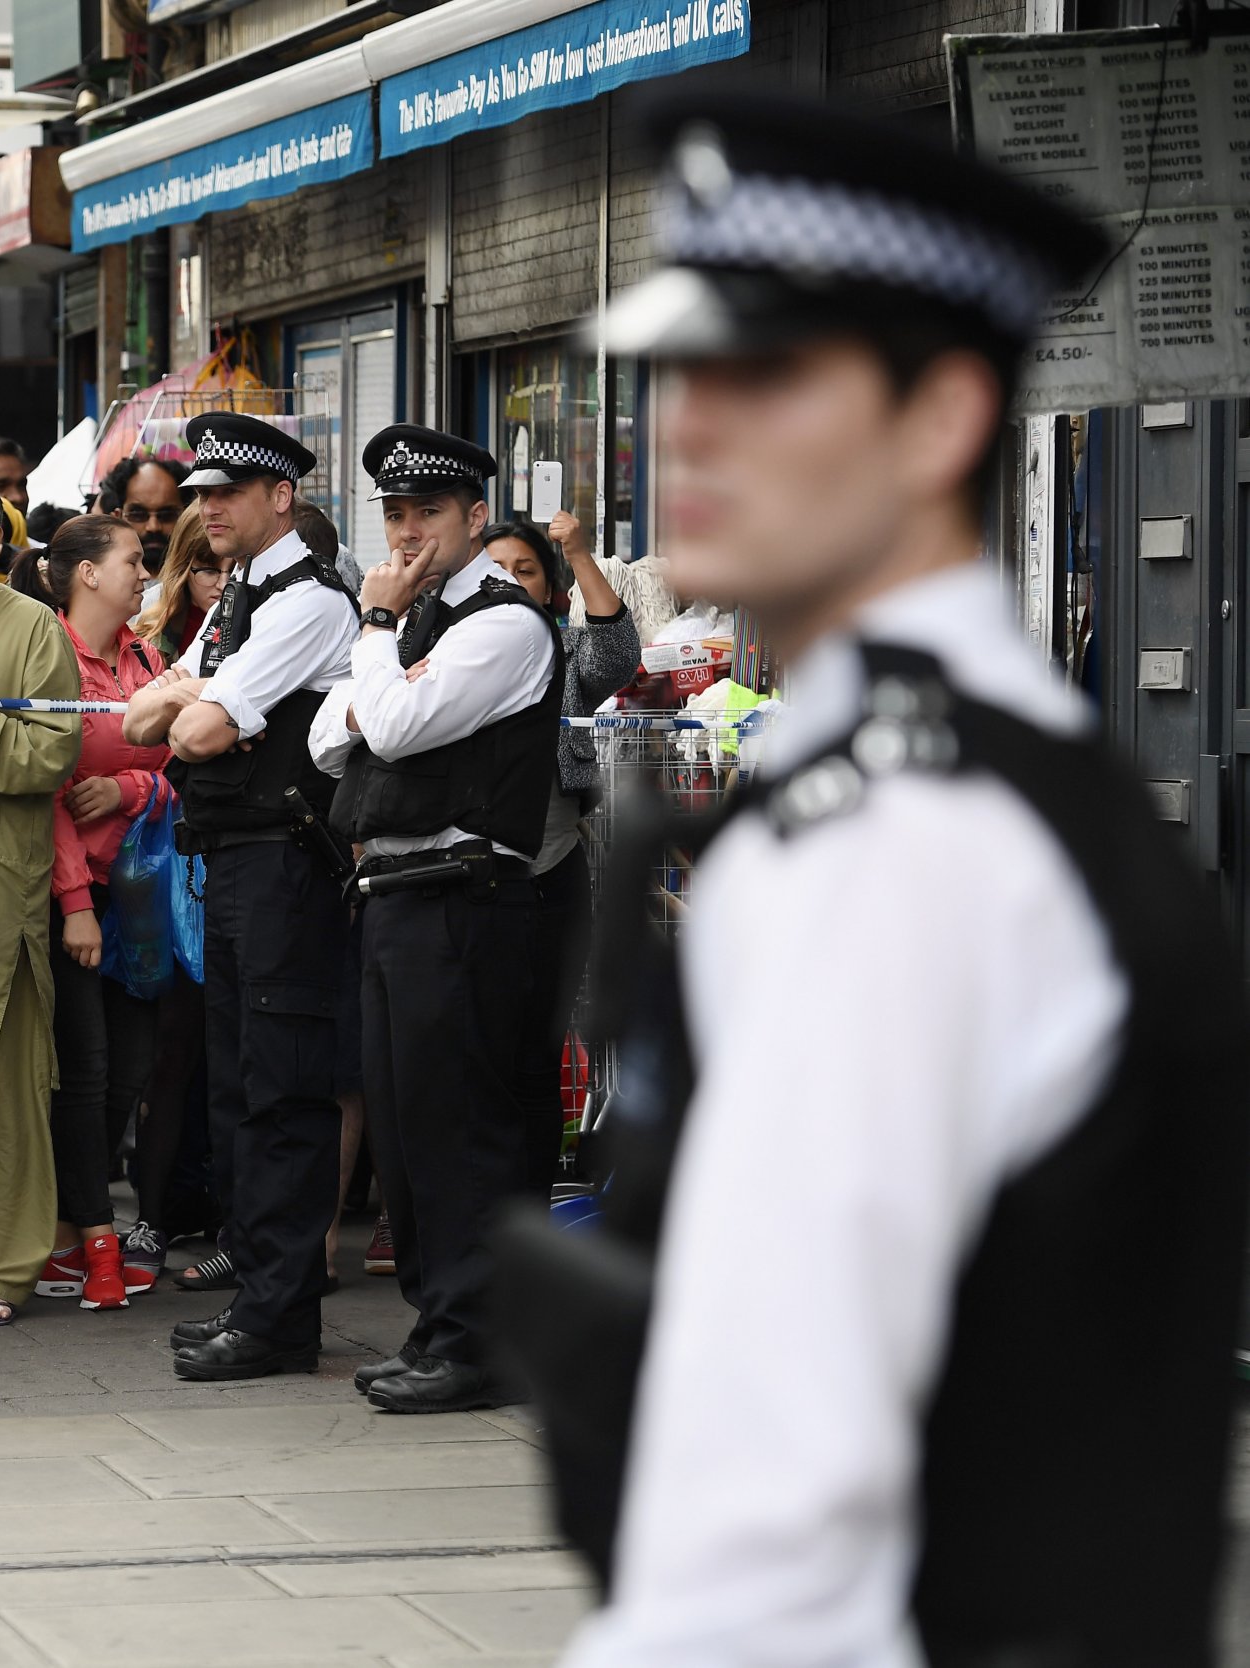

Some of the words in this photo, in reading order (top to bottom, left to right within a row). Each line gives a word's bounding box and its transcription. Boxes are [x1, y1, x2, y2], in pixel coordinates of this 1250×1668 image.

[1101, 51, 1150, 64] NIGERIA
[399, 99, 414, 134] The
[414, 92, 433, 129] UK's
[434, 80, 469, 124] favourite
[468, 74, 486, 115] Pay
[486, 68, 500, 105] As
[501, 64, 516, 100] You
[518, 58, 530, 95] Go
[529, 50, 548, 91] SIM
[547, 47, 564, 85] for
[565, 43, 584, 81] low
[586, 33, 605, 74] cost
[605, 10, 671, 67] International
[673, 3, 691, 48] and
[692, 0, 710, 41] UK
[982, 60, 1027, 71] MOBILE
[989, 90, 1036, 102] LEBARA
[1040, 86, 1086, 98] MOBILE
[1010, 103, 1066, 116] VECTONE
[1118, 99, 1138, 110] 100
[1143, 108, 1197, 122] MNUTES
[1014, 119, 1064, 131] DELIGHT
[1145, 124, 1199, 137] MNUTES
[1003, 137, 1031, 147] NOW
[1034, 133, 1080, 144] MOBILE
[998, 152, 1038, 163] WHITE
[1041, 148, 1086, 159] MOBILE
[1150, 155, 1202, 167] MINUTES
[1150, 170, 1204, 183] MINUTES
[1174, 211, 1218, 223] OFFERS
[1157, 243, 1208, 255] MINUTES
[1138, 261, 1158, 271] 100
[1161, 258, 1211, 270] MINUTES
[1138, 276, 1158, 287] 125
[1161, 273, 1211, 285] MINUTES
[1138, 292, 1159, 302] 250
[1161, 288, 1212, 300] MINUTES
[1053, 297, 1099, 308] MOBLE
[1162, 304, 1212, 315] MINUTES
[1060, 313, 1105, 324] MOBILE
[1163, 319, 1213, 331] MINUTES
[1141, 338, 1160, 348] 700
[1164, 334, 1215, 346] MINUTES
[1035, 346, 1093, 362] £4.50/-
